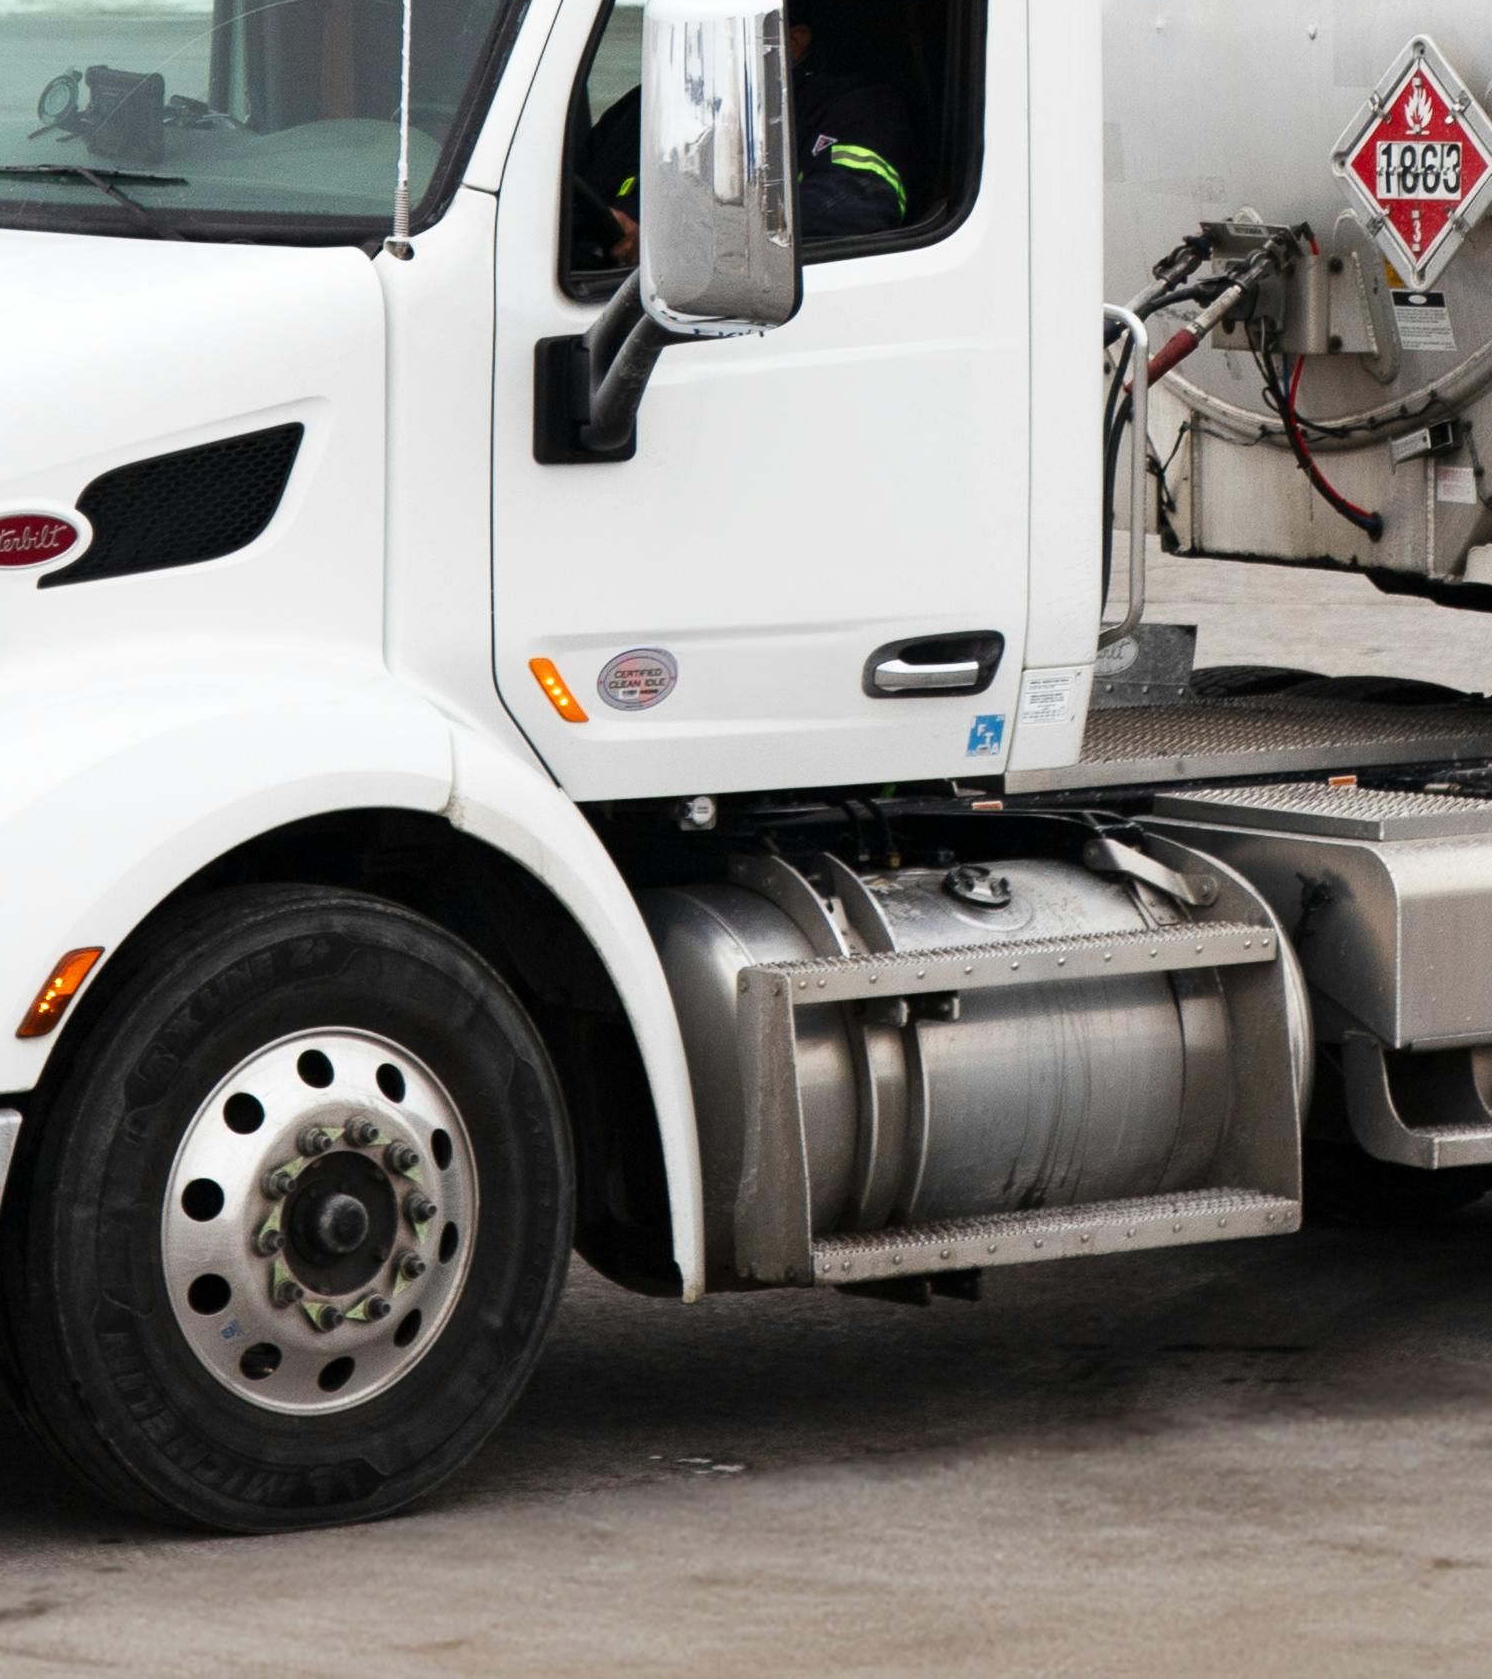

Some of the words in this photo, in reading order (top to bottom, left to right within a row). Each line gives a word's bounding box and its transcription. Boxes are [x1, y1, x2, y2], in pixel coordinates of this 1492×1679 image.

[1380, 142, 1461, 194] 1863
[1412, 220, 1422, 242] 3
[609, 679, 641, 690] CLEAN
[644, 677, 666, 688] IDLE
[614, 668, 663, 679] CERTIFIED
[98, 1331, 299, 1503] MICHELIN
